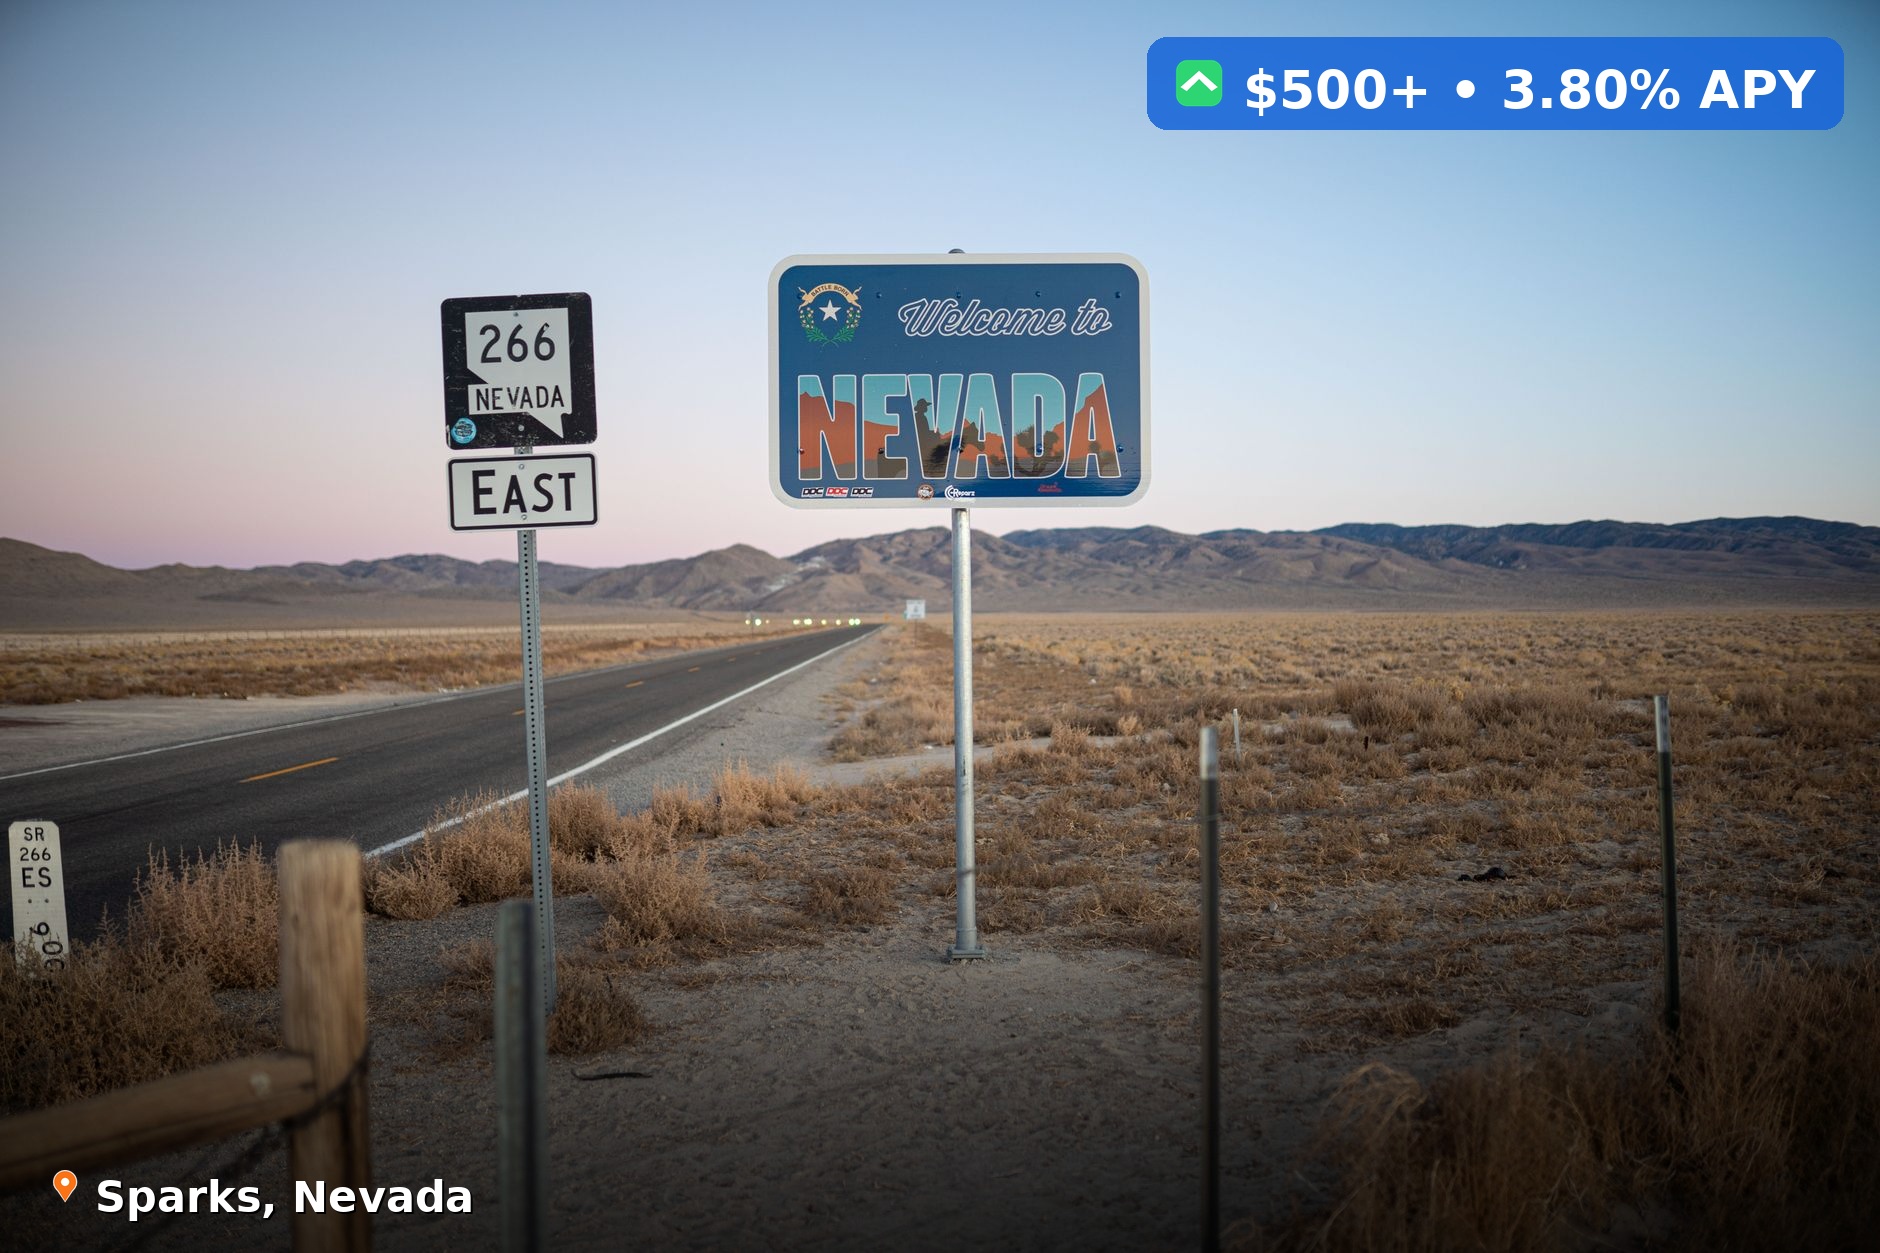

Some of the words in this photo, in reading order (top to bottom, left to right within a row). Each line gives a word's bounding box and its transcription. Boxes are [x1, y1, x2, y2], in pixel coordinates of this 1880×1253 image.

[810, 284, 832, 297] BATTLE
[833, 284, 850, 297] BORN
[898, 298, 1066, 337] Welcome
[1071, 298, 1112, 336] to
[479, 322, 556, 363] 266
[475, 384, 565, 412] NEVADA
[797, 372, 1122, 481] NEVADA
[471, 468, 576, 515] EAST
[23, 826, 45, 842] SR
[19, 847, 51, 862] 266
[21, 867, 52, 888] ES
